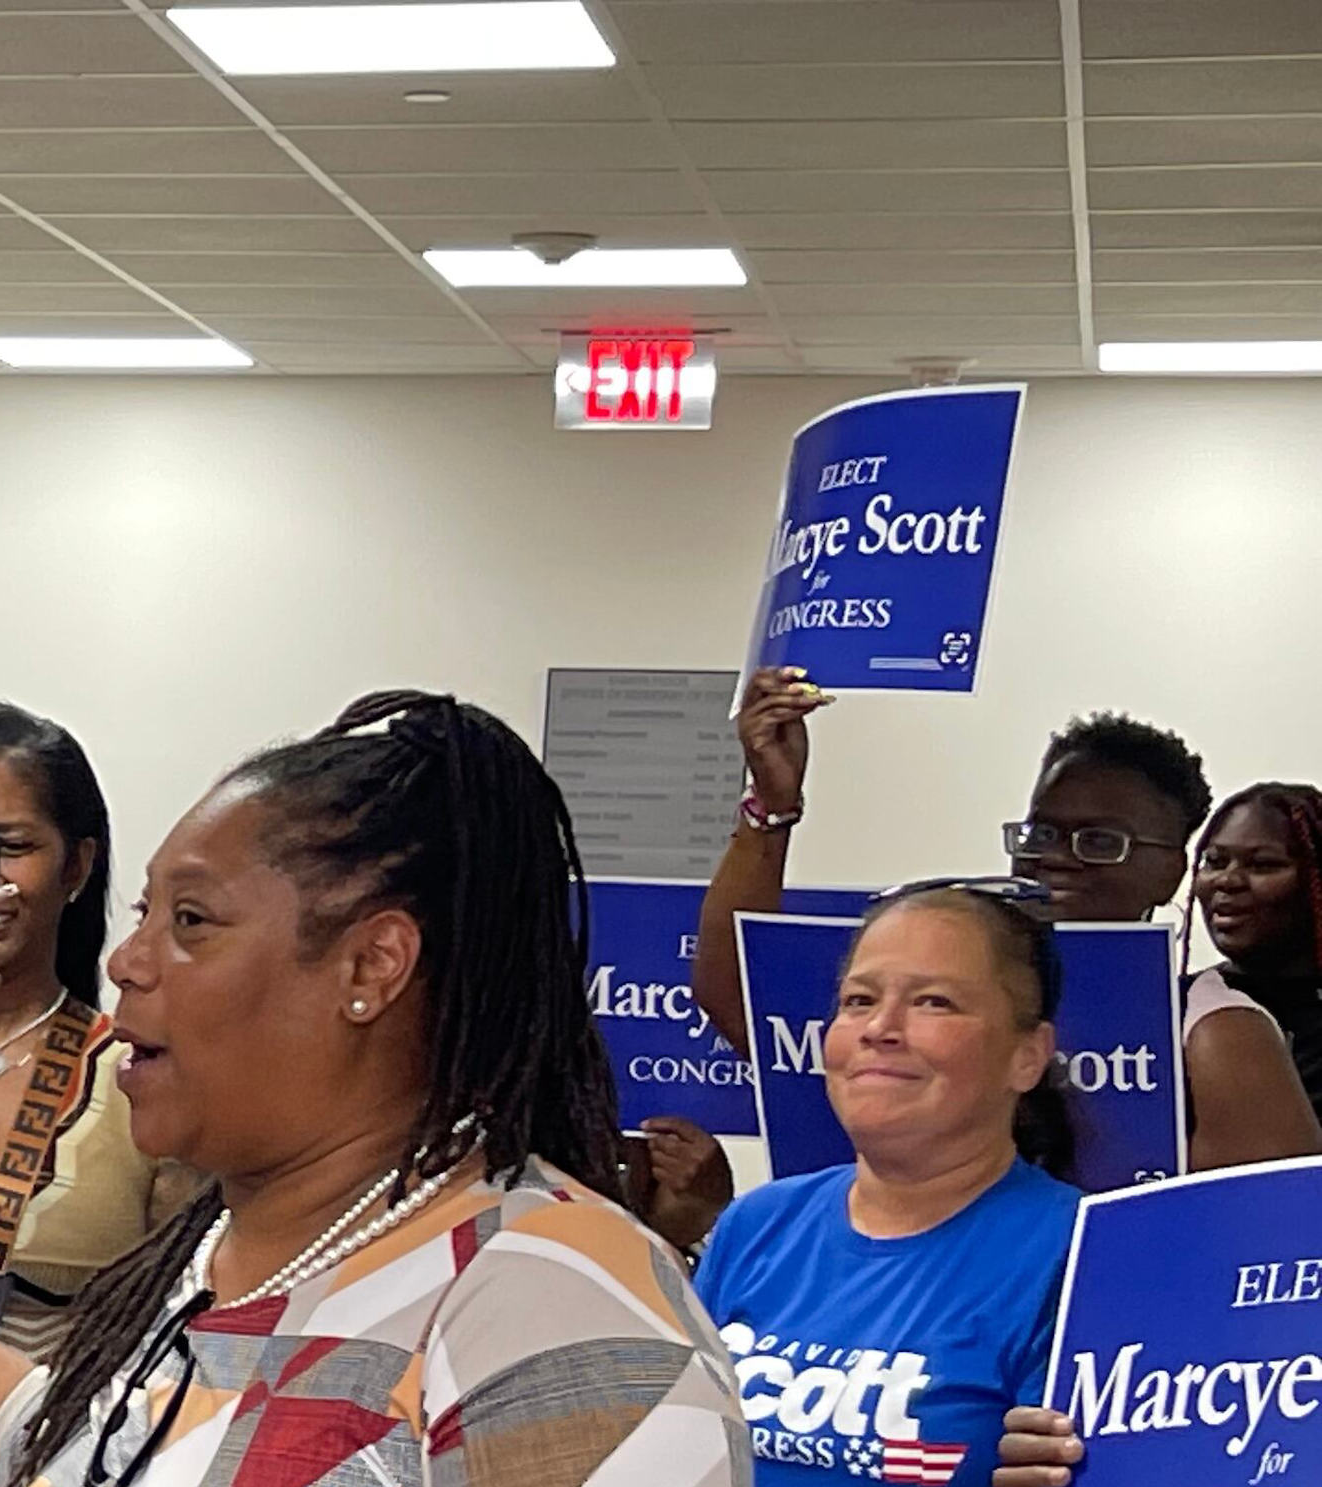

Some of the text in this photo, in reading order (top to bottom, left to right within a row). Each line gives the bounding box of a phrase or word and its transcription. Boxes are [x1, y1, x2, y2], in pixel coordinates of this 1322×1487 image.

[585, 340, 695, 422] EXIT
[817, 455, 888, 494] ELECT
[858, 493, 987, 554] Scott
[768, 597, 894, 639] CONGRESS
[628, 1055, 755, 1086] CONGR
[1230, 1257, 1322, 1309] ELE
[755, 1333, 862, 1367] DAVID
[1068, 1341, 1322, 1457] Marcye
[752, 1427, 836, 1469] RESS
[1247, 1441, 1295, 1486] for
